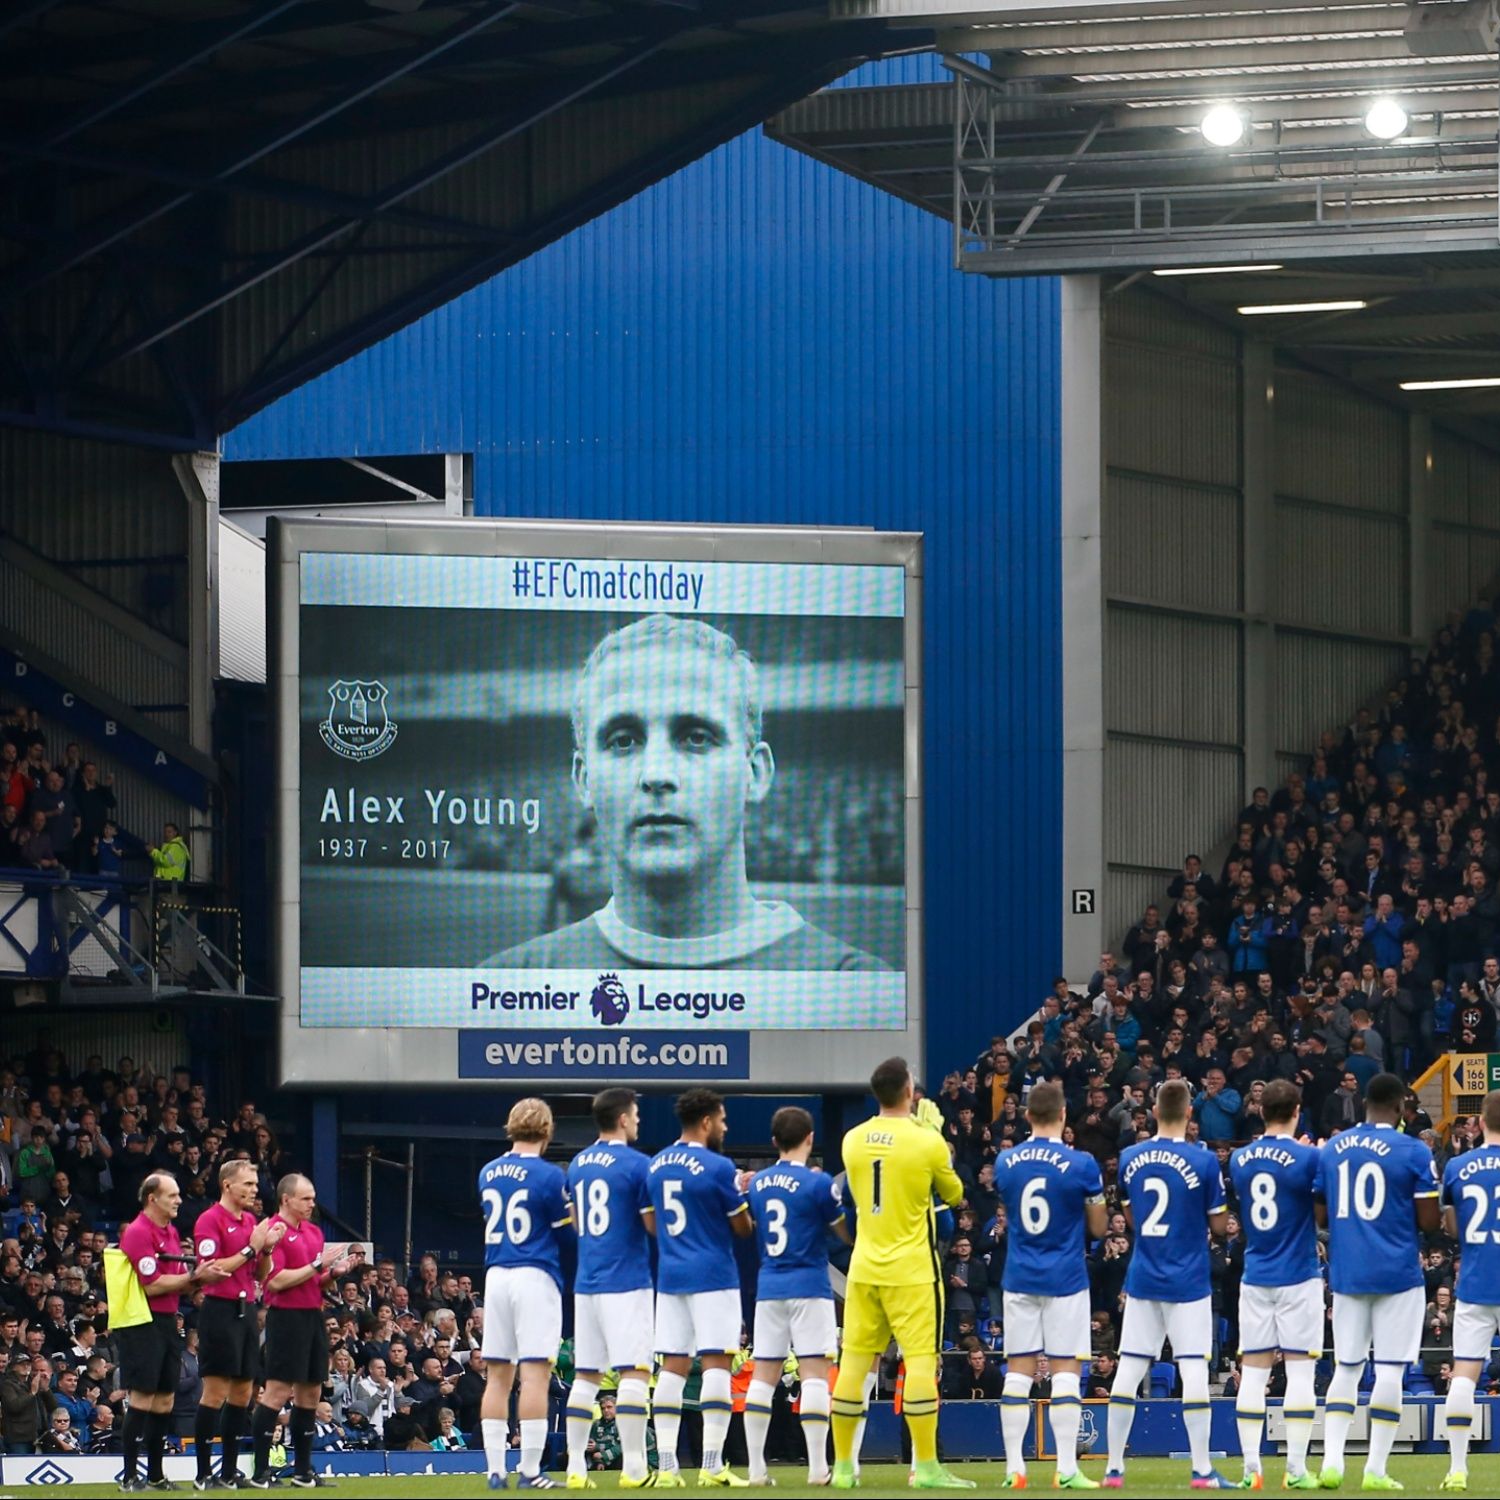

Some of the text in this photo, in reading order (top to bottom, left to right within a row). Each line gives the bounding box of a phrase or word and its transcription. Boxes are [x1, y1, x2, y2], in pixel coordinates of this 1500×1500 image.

[512, 561, 704, 610] #EFCmatchday
[15, 661, 28, 677] D
[62, 692, 75, 708] C
[105, 720, 118, 736] B
[337, 723, 380, 736] Everton
[154, 750, 168, 766] A
[319, 787, 541, 835] Alex Young
[318, 838, 368, 858] 1937
[401, 839, 451, 859] 2017
[1075, 890, 1092, 913] R
[471, 983, 746, 1019] Premier League
[485, 1036, 728, 1066] evertonfc.com
[1466, 1058, 1485, 1066] SEATS
[1466, 1069, 1485, 1080] 166
[1466, 1080, 1485, 1091] 180
[865, 1132, 894, 1146] JOEL
[1334, 1135, 1391, 1157] LUKAKU
[577, 1152, 616, 1168] BARRY
[650, 1153, 704, 1176] WILLIAMS
[1005, 1148, 1071, 1174] JAGIELKA
[1237, 1147, 1296, 1168] BARKLEY
[486, 1164, 528, 1182] DAVIES
[1123, 1150, 1201, 1190] SCHNEIDERLIN
[755, 1174, 800, 1193] BAINES
[872, 1159, 882, 1215] 1
[1336, 1159, 1385, 1221] 10
[575, 1178, 610, 1237] 18
[662, 1179, 687, 1237] 5
[1020, 1177, 1050, 1236] 6
[1141, 1177, 1170, 1237] 2
[1250, 1172, 1279, 1231] 8
[482, 1188, 532, 1245] 26
[765, 1198, 788, 1257] 3
